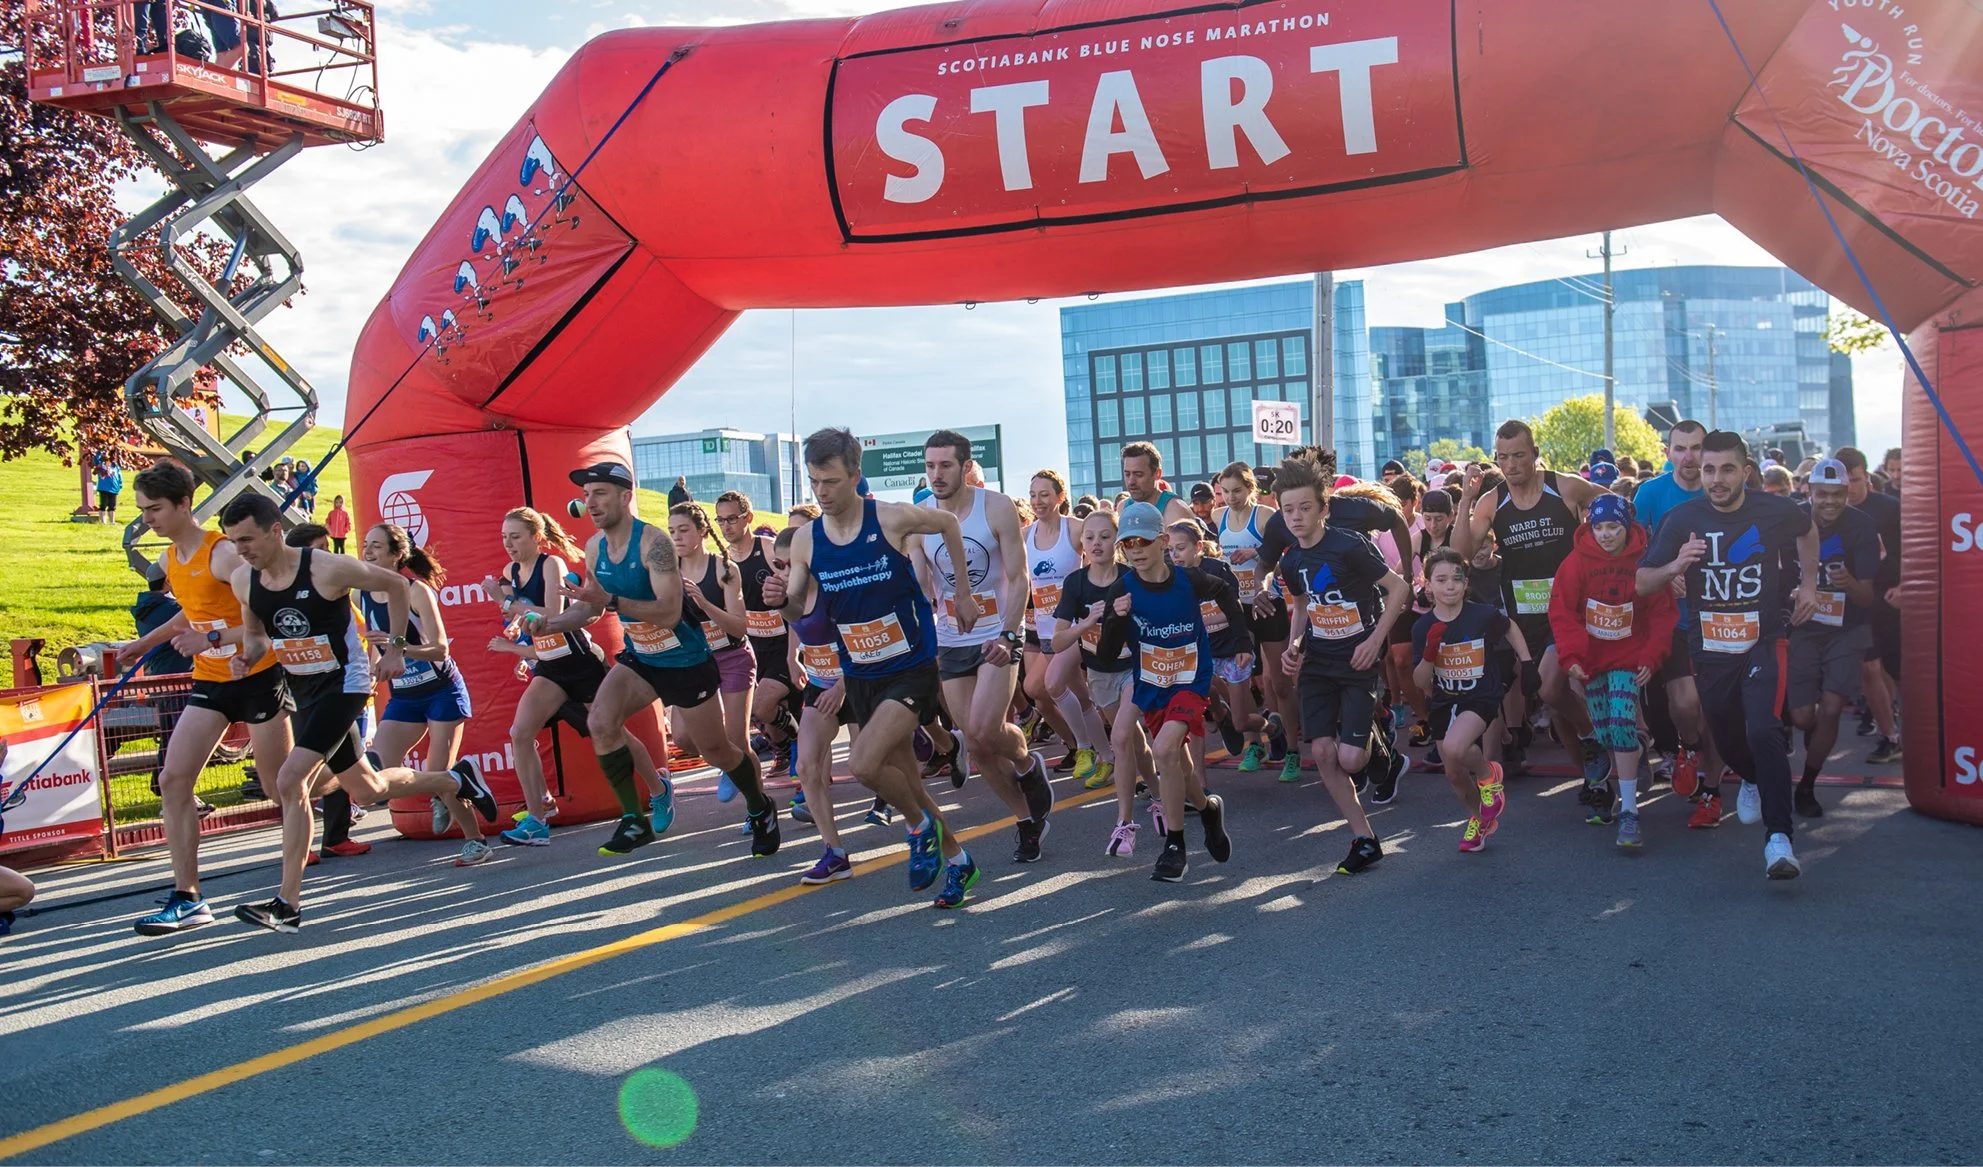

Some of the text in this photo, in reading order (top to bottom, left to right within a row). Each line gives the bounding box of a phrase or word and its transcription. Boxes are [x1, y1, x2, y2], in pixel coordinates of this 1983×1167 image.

[937, 13, 1330, 76] SCOTIABANK BLUE NOSE MARATHON
[1903, 24, 1923, 65] RUN
[176, 63, 226, 84] SKYJACK
[1899, 70, 1919, 90] For
[1916, 81, 1954, 115] doctors.
[1955, 110, 1973, 129] For
[875, 36, 1398, 204] START
[1854, 118, 1980, 218] Nova Scotia
[1261, 418, 1293, 434] 0:20
[882, 452, 902, 460] Halifax
[884, 476, 916, 488] Canada
[1509, 517, 1554, 534] WARD ST.
[1502, 529, 1541, 547] RUNNING
[1541, 527, 1565, 537] CLUB
[818, 565, 860, 581] Bluenose
[822, 570, 893, 592] Physiotherapy
[1240, 580, 1254, 589] 059
[1701, 563, 1763, 601] NS
[1041, 595, 1057, 605] ERIN
[748, 619, 777, 627] BRADLEY
[1316, 615, 1350, 625] GRIFFIN
[1593, 615, 1623, 628] 11245
[1146, 622, 1195, 638] kingfisher
[1324, 627, 1346, 636] 9611
[1711, 626, 1747, 639] 11064
[852, 632, 891, 649] 11058
[286, 649, 322, 662] 11158
[811, 657, 832, 666] ABBY
[860, 650, 882, 660] GREG
[1443, 655, 1473, 666] LYDIA
[1151, 660, 1185, 671] COHEN
[1445, 669, 1473, 677] 10051
[1954, 745, 1983, 786] S
[9, 829, 66, 844] TITLE SPONSOR
